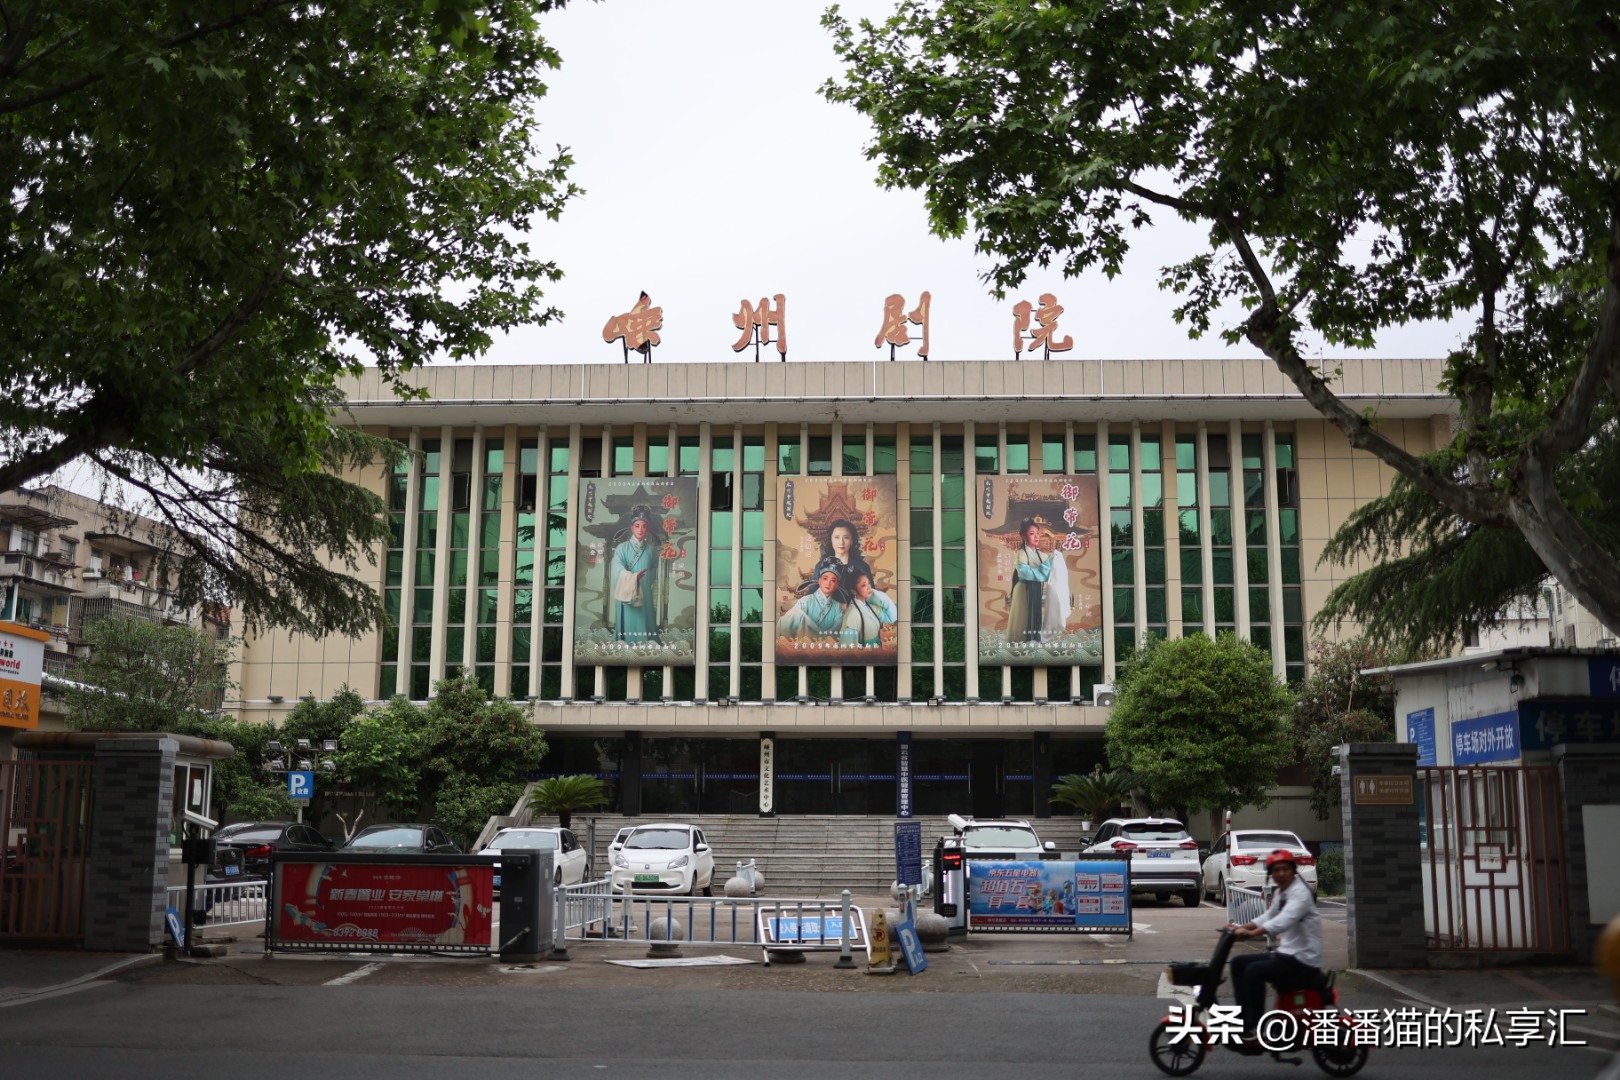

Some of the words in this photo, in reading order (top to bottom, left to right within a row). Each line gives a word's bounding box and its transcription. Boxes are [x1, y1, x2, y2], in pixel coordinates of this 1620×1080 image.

[602, 291, 1073, 356] 嵊州剧院
[1455, 724, 1514, 757] 停车场对外开放
[329, 888, 385, 902] 新春置业
